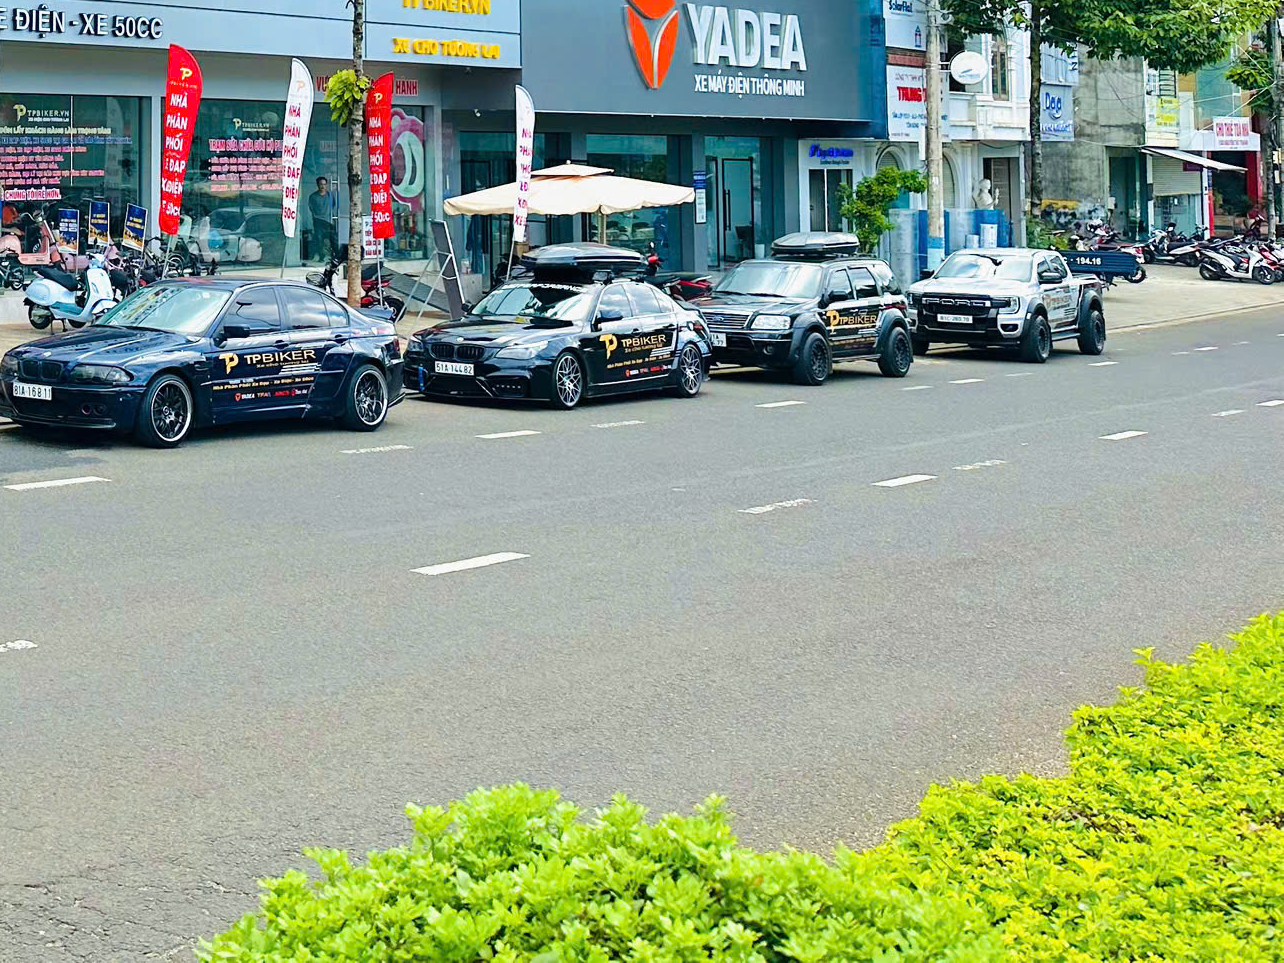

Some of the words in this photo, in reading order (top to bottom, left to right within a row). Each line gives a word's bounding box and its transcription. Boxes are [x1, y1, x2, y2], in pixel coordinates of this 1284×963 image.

[15, 3, 65, 38] ĐIỆN
[80, 13, 108, 35] XE
[113, 15, 163, 40] 50CC
[684, 2, 807, 72] YADEA
[695, 74, 708, 92] XE
[708, 69, 727, 93] MÁY
[727, 72, 750, 98] ĐIỆN
[751, 73, 783, 95] THÔNG
[783, 80, 805, 97] MINH
[170, 92, 188, 108] NHÀ
[289, 102, 301, 117] NHÀ
[284, 122, 301, 138] PHÂN
[166, 133, 183, 151] PHỐI
[284, 141, 298, 158] PHỐI
[839, 314, 876, 325] TPBIKER
[621, 334, 666, 348] TPBIKER
[244, 349, 316, 364] TPBIKER
